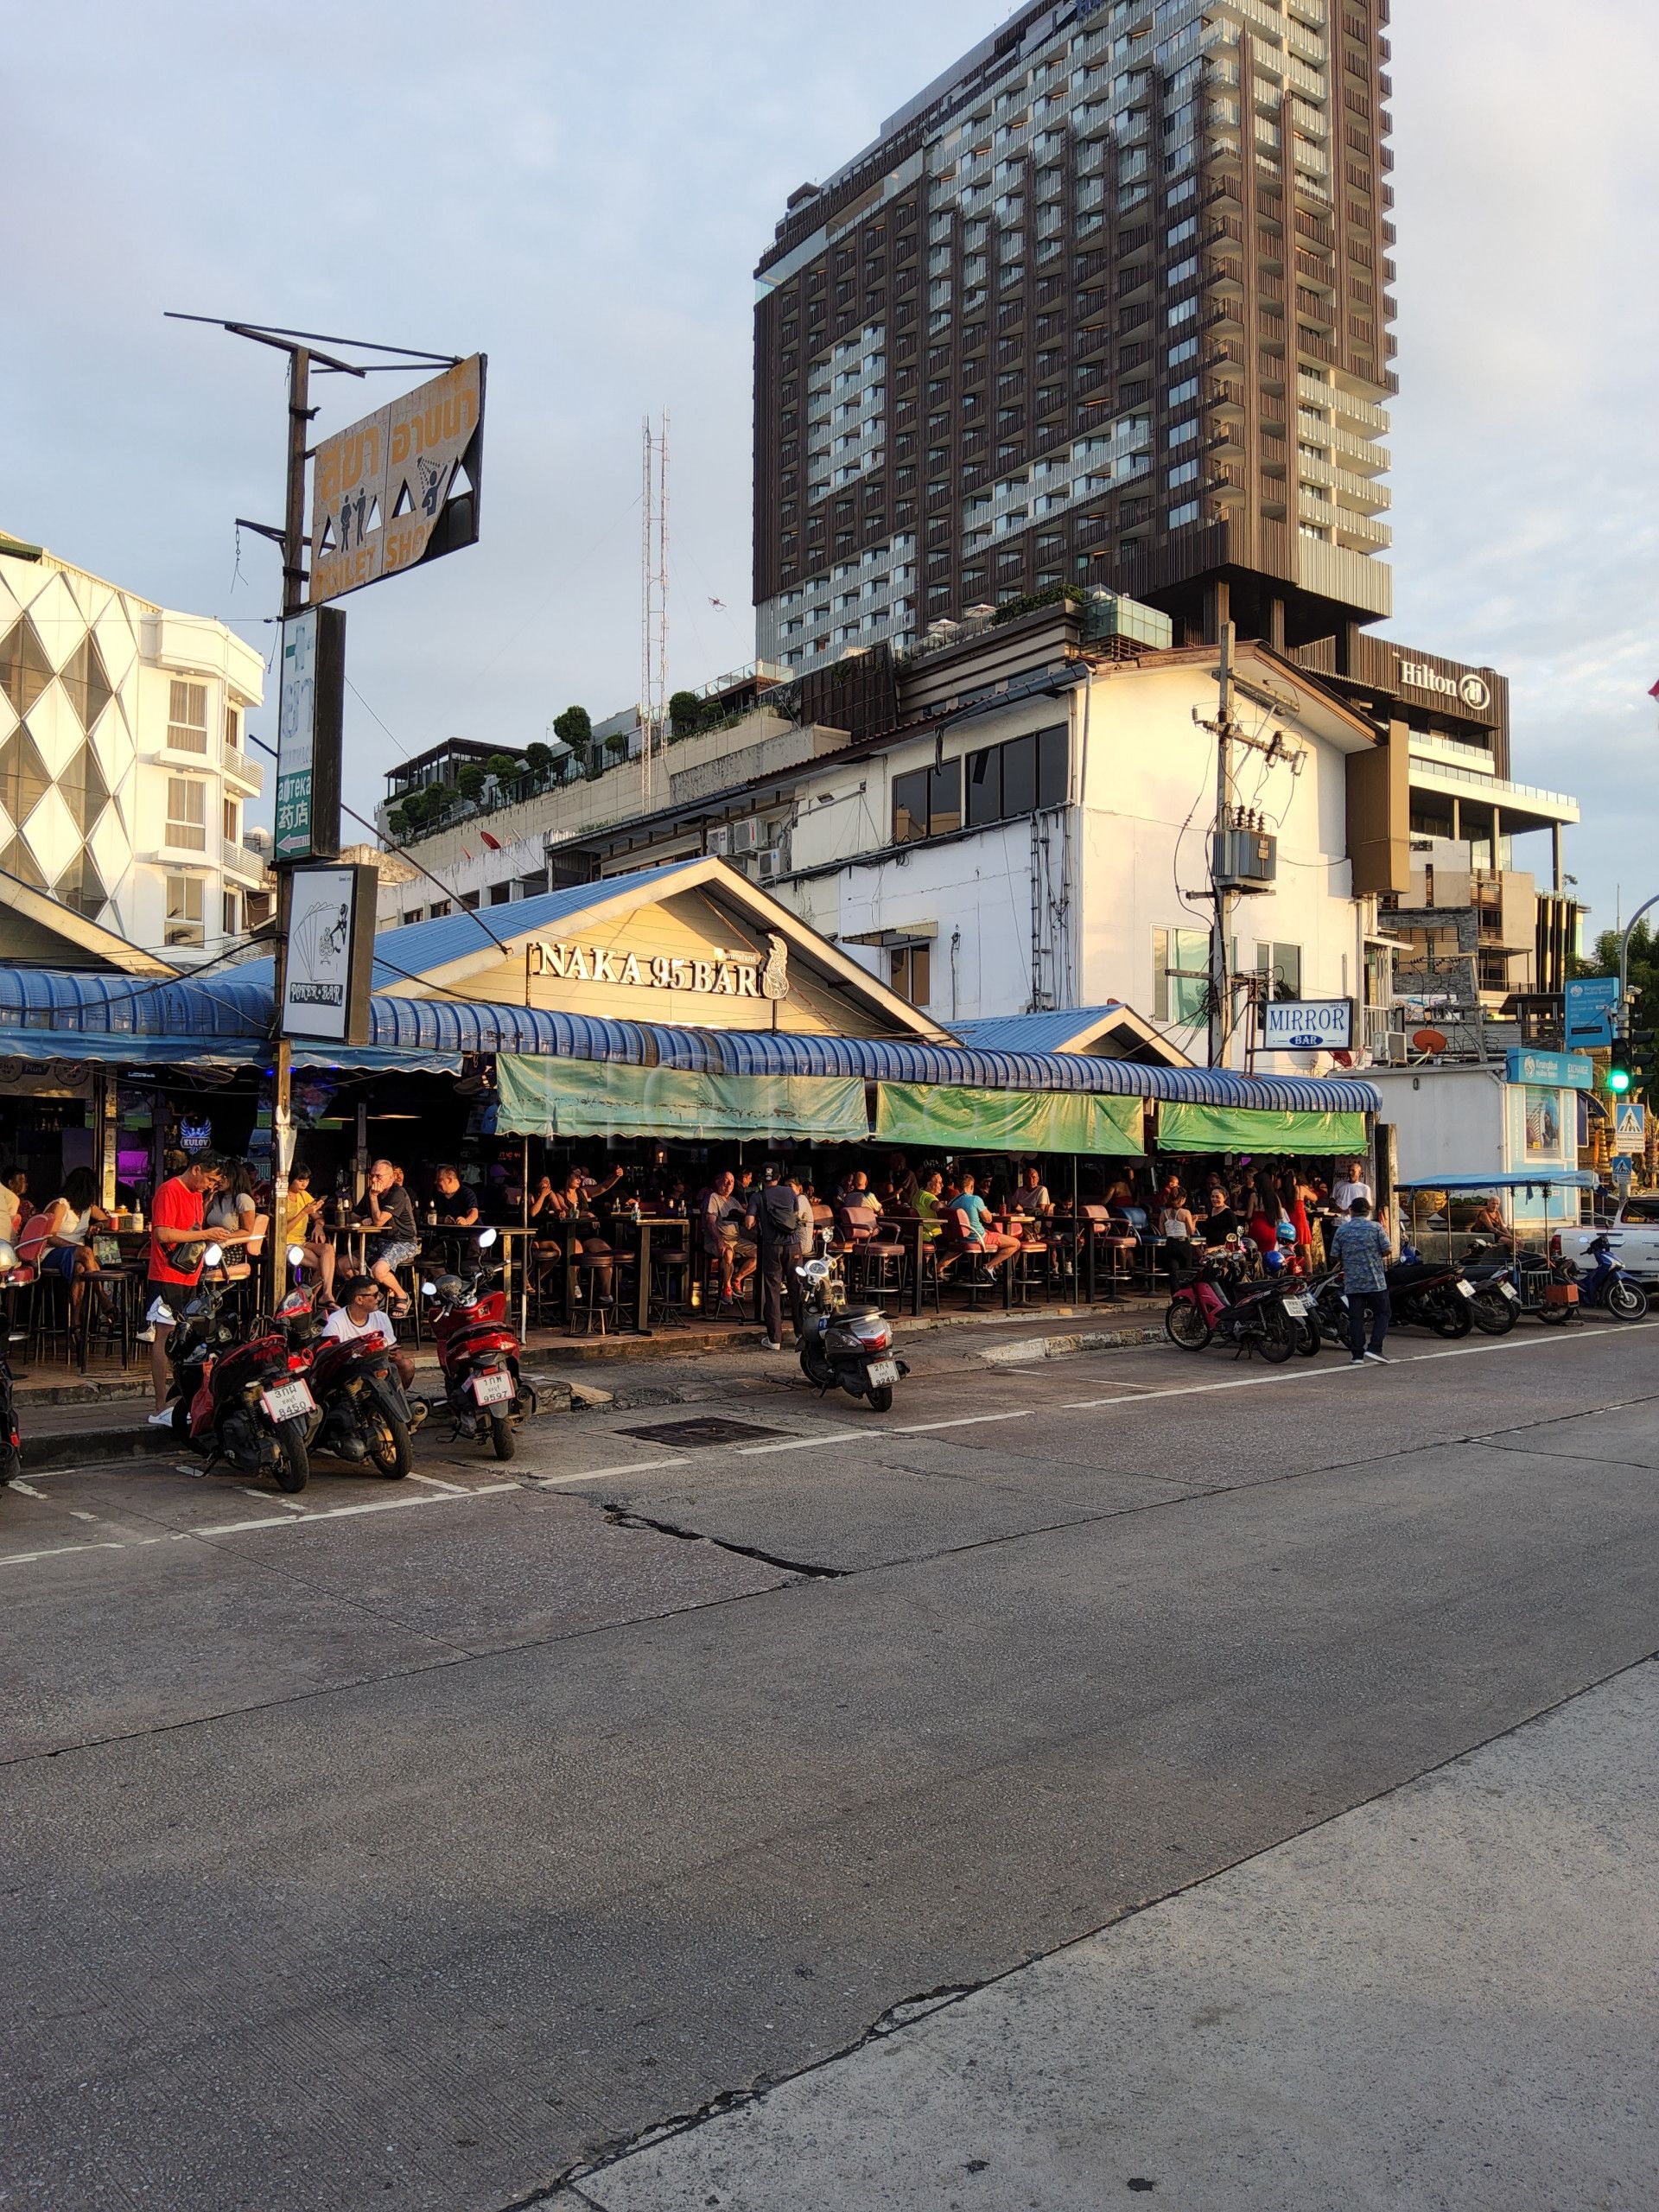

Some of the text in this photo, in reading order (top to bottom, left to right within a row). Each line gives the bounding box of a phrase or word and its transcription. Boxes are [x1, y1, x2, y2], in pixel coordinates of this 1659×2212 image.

[315, 546, 376, 596] TOILET
[1401, 660, 1458, 697] Hilton
[278, 800, 308, 830] 药店
[537, 942, 763, 998] NAKA 95 BAR
[291, 983, 342, 1005] POKER BAR
[1269, 1008, 1344, 1031] MIRROR
[1294, 1036, 1317, 1045] BAR
[183, 1138, 208, 1147] KULOV
[483, 1390, 508, 1403] 9597
[278, 1401, 307, 1417] 8450
